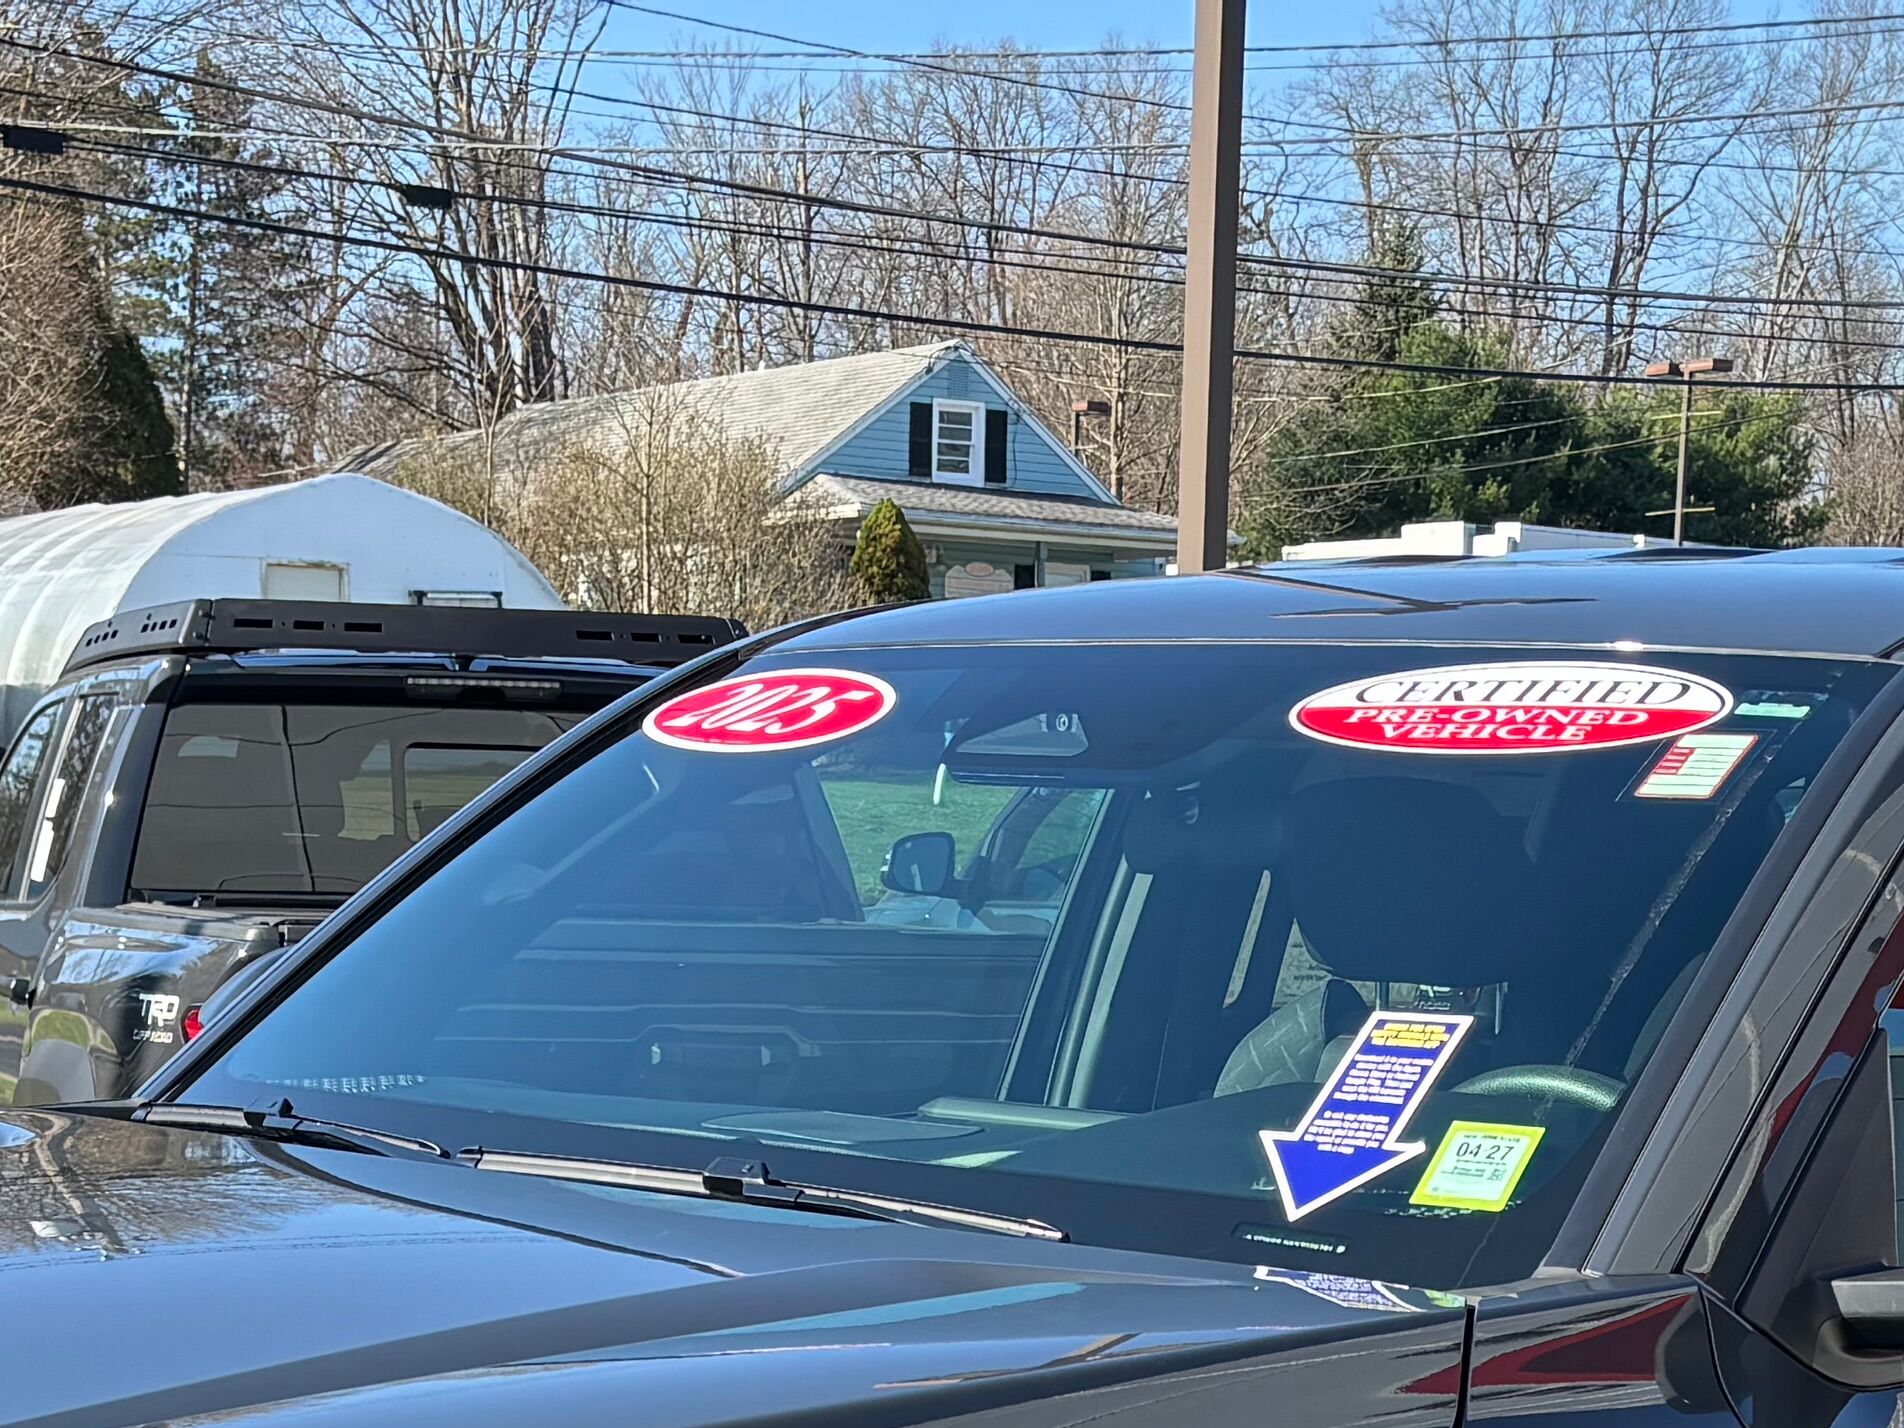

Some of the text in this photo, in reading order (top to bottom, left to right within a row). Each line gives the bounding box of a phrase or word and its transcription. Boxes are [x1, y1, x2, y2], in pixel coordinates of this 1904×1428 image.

[1355, 679, 1692, 706] CERTIFIED
[662, 682, 876, 736] 2025
[1343, 707, 1649, 726] PRE-OWNED
[1382, 723, 1592, 742] VEHICLE
[139, 993, 180, 1027] TRD
